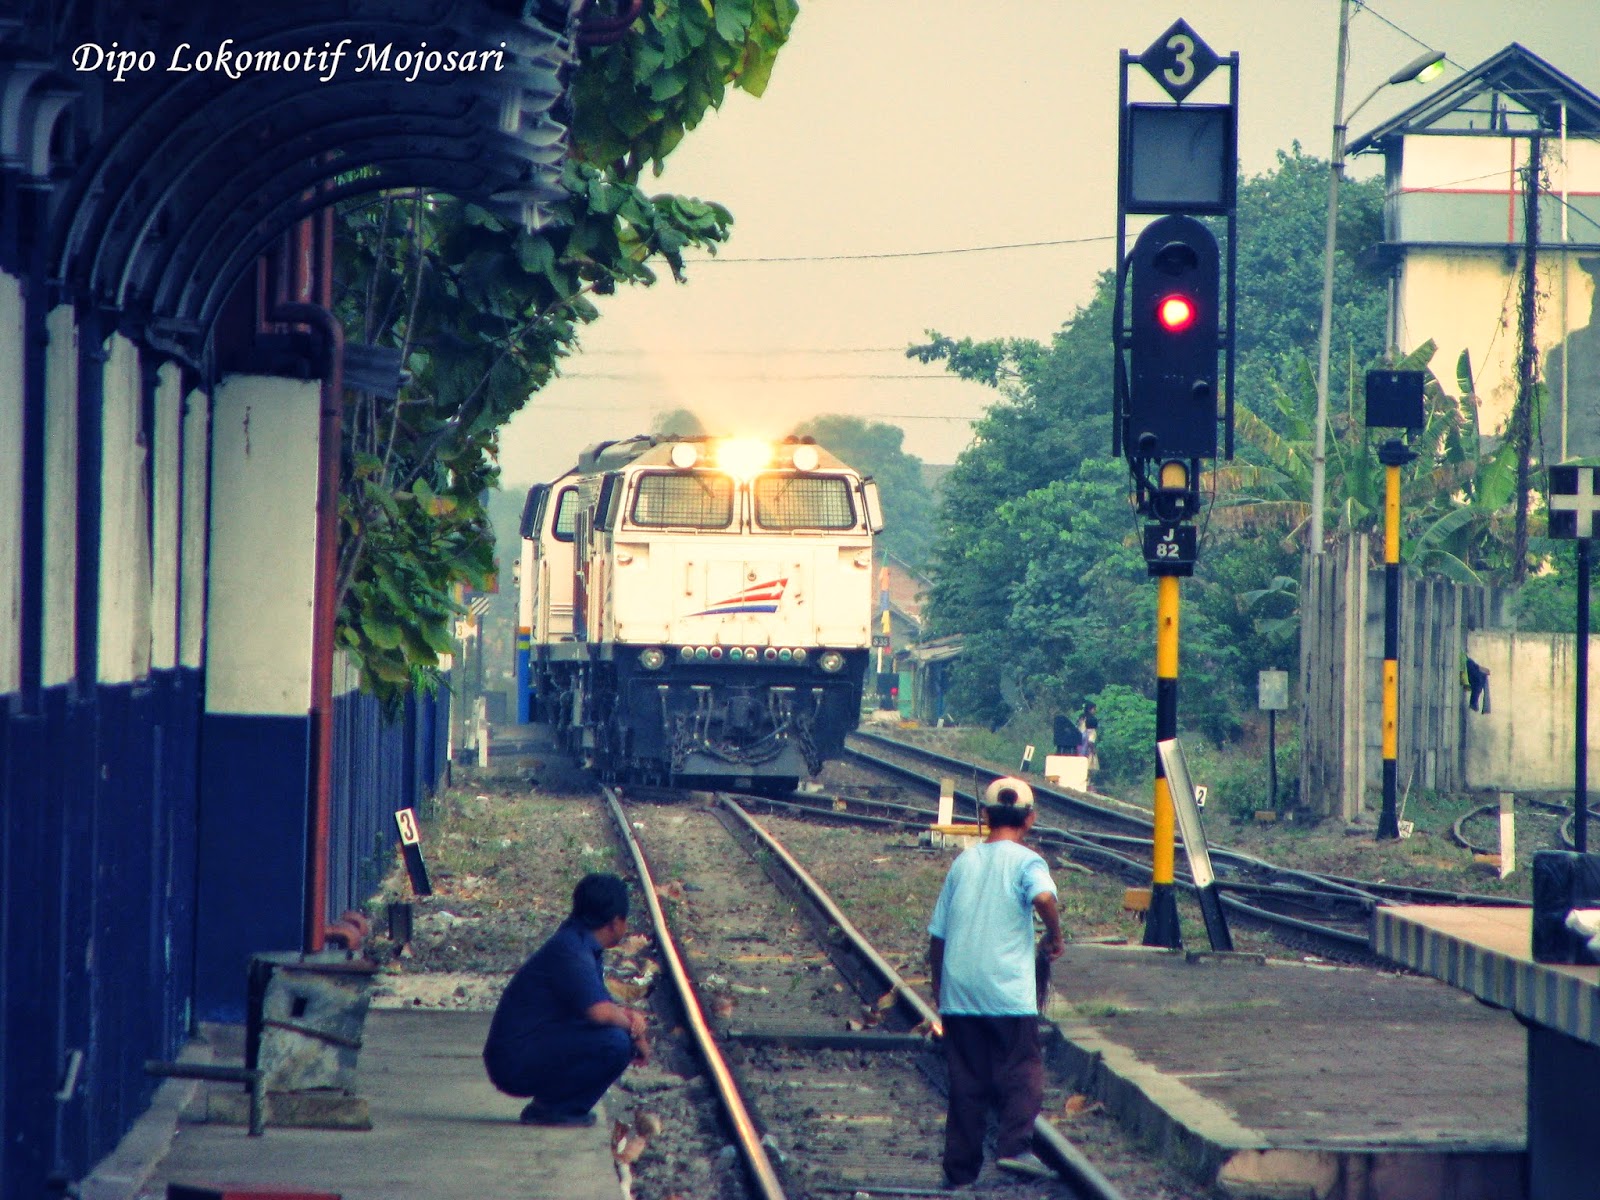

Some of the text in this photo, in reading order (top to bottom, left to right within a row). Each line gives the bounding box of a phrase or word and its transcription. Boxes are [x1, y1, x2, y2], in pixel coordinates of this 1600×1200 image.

[1163, 33, 1195, 86] 3
[1162, 528, 1175, 541] J
[1156, 543, 1180, 559] 82
[1197, 789, 1205, 804] 2
[400, 812, 414, 841] 3
